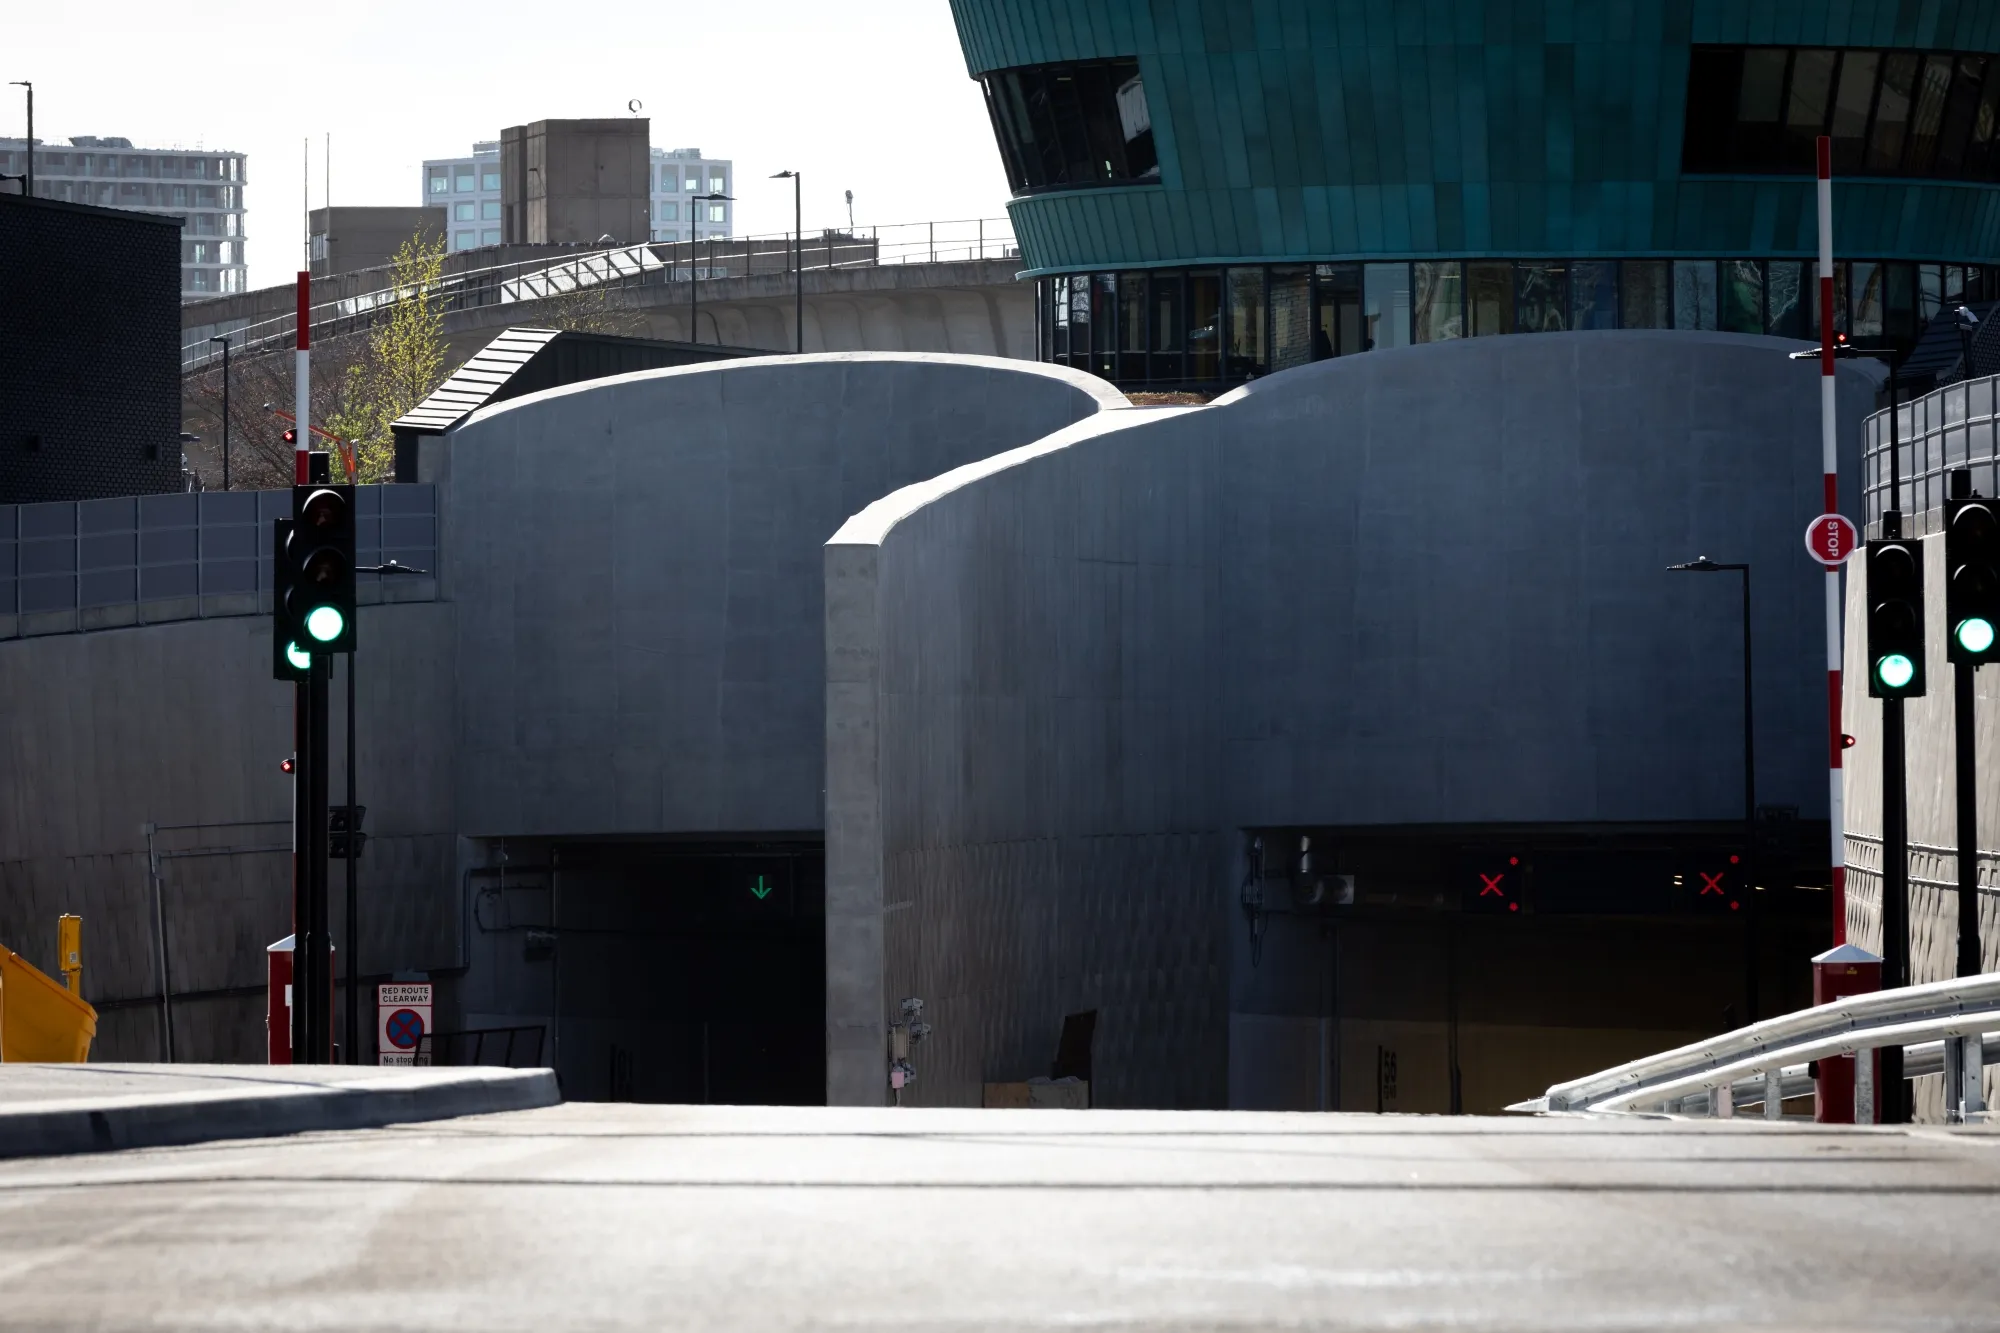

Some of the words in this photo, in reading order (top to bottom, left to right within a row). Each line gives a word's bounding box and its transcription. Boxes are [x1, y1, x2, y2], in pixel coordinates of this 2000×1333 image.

[1827, 521, 1839, 557] STOP
[383, 1056, 394, 1064] No
[396, 1056, 429, 1066] stopng
